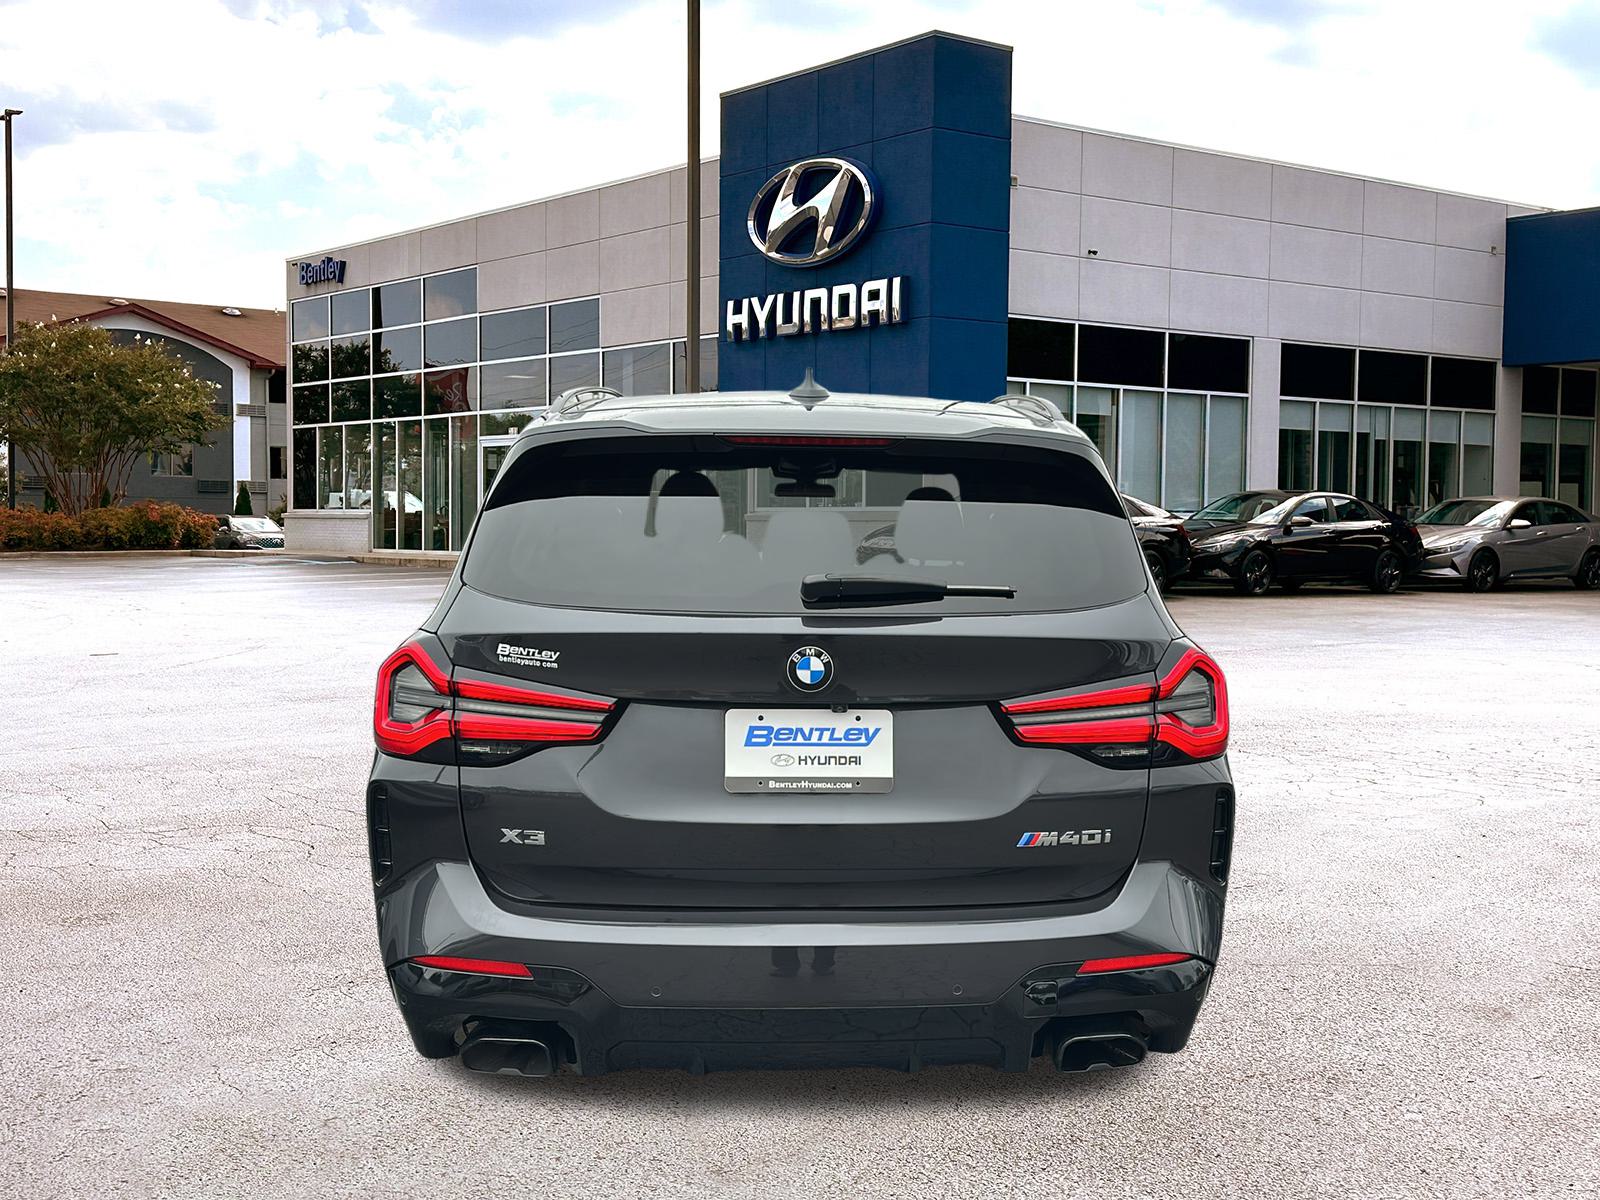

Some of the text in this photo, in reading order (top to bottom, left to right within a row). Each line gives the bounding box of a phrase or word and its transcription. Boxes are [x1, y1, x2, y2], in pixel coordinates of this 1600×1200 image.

[299, 257, 344, 284] Bentley
[726, 276, 902, 342] HYUNDAI
[792, 648, 830, 663] BMW
[798, 755, 862, 766] HYUNDAI
[500, 828, 545, 845] X3
